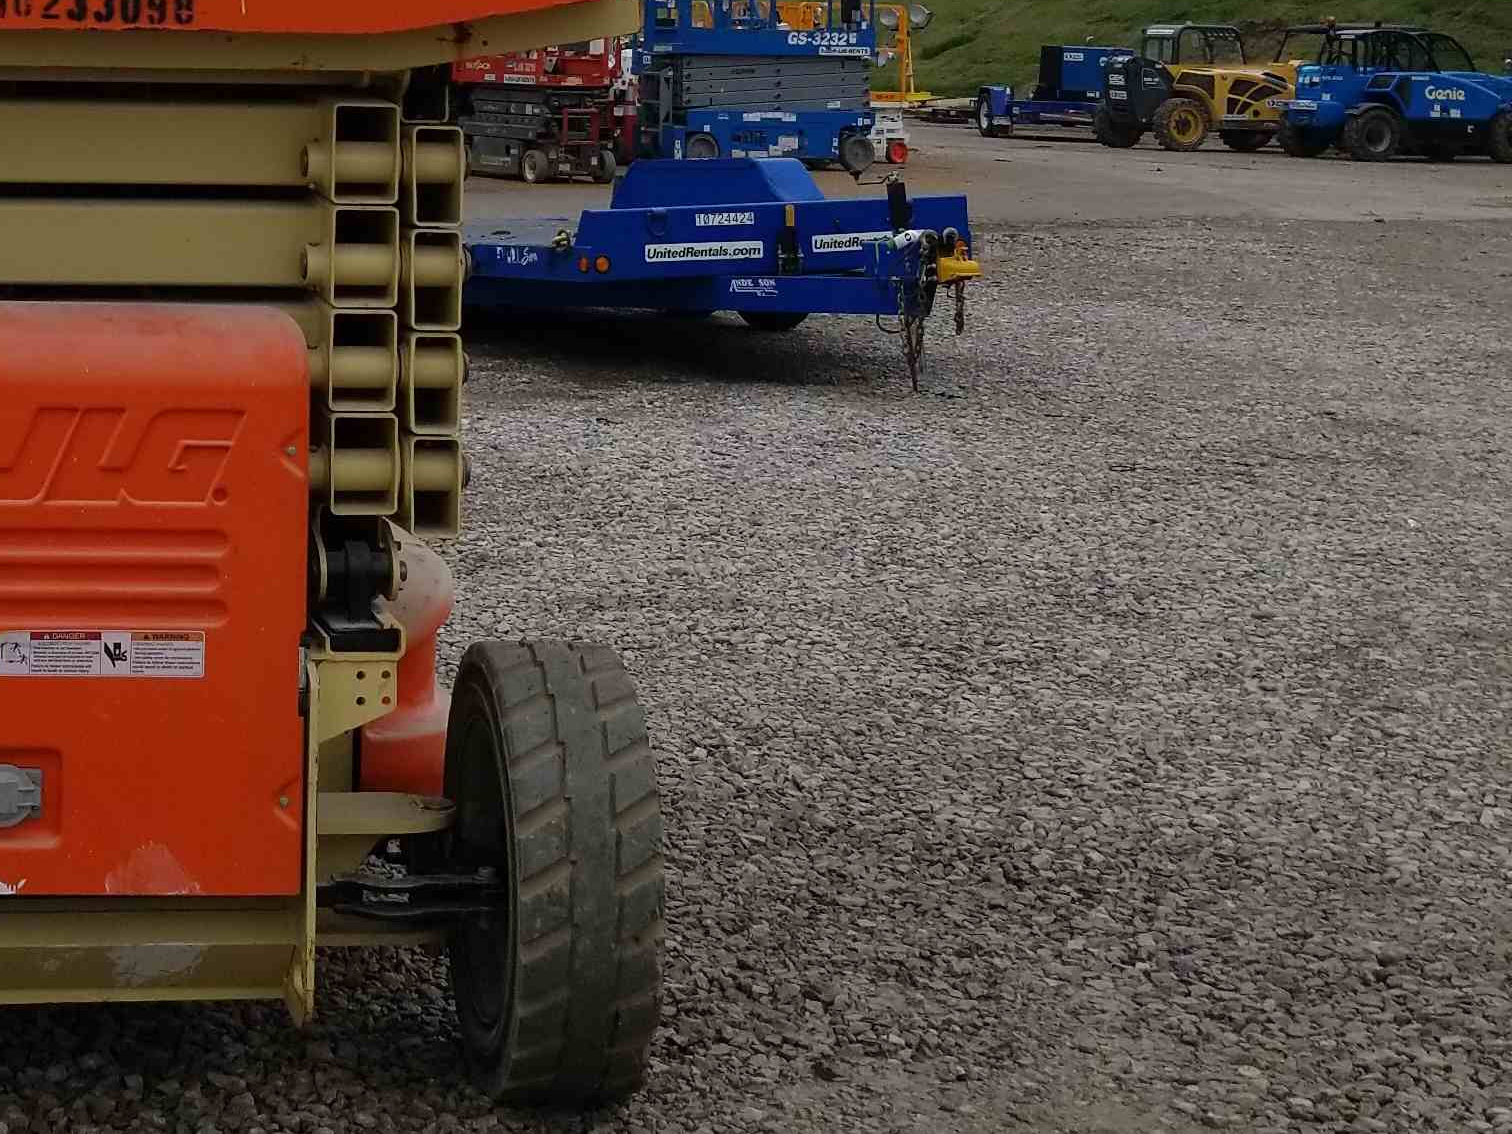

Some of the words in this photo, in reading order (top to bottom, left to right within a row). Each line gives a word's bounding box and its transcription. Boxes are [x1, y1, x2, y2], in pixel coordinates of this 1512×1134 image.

[788, 32, 848, 46] GS-3232
[1424, 85, 1465, 100] Genie
[696, 212, 754, 226] 10724424
[647, 245, 761, 260] UnitedRentals.com
[52, 632, 87, 641] DANGER
